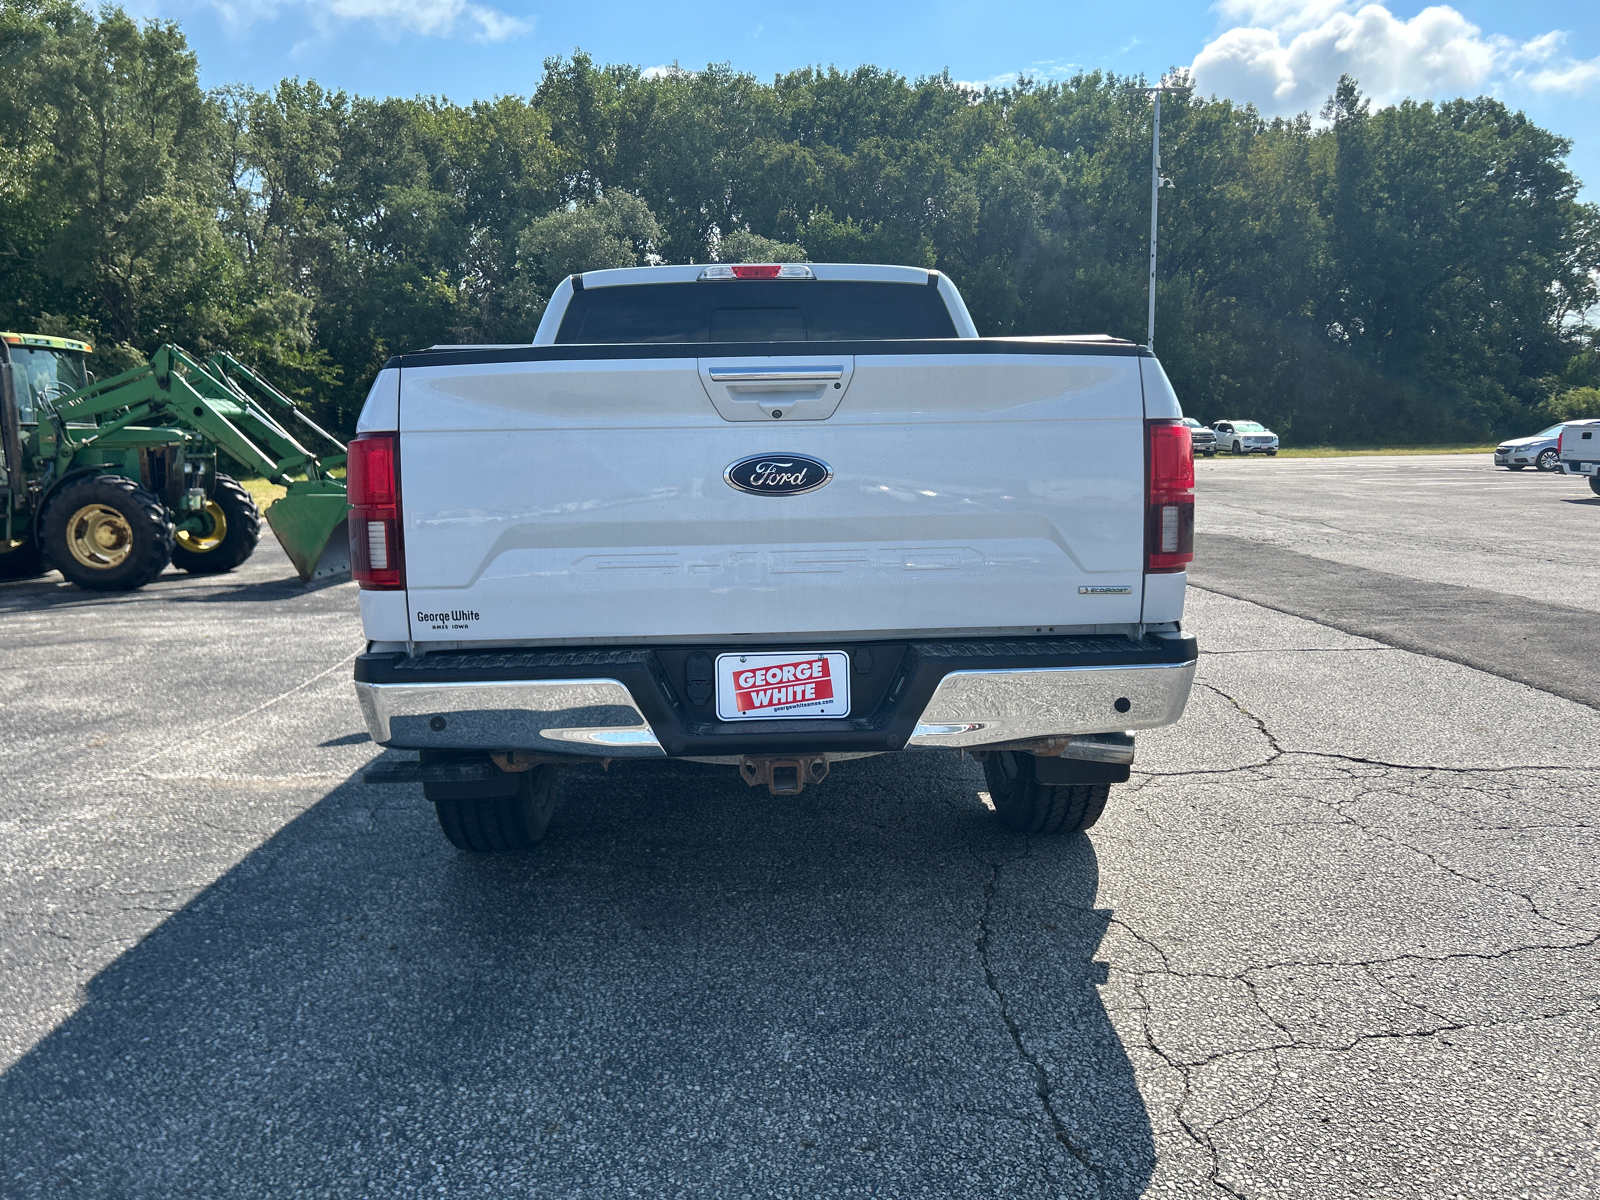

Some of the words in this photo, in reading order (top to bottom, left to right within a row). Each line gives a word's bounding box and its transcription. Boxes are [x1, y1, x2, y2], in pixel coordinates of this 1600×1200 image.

[750, 461, 808, 486] Ford
[417, 611, 450, 624] George
[451, 610, 480, 621] White
[738, 661, 823, 688] GEORGE
[750, 683, 816, 707] WHITE
[773, 699, 834, 713] georgewhiteames.com
